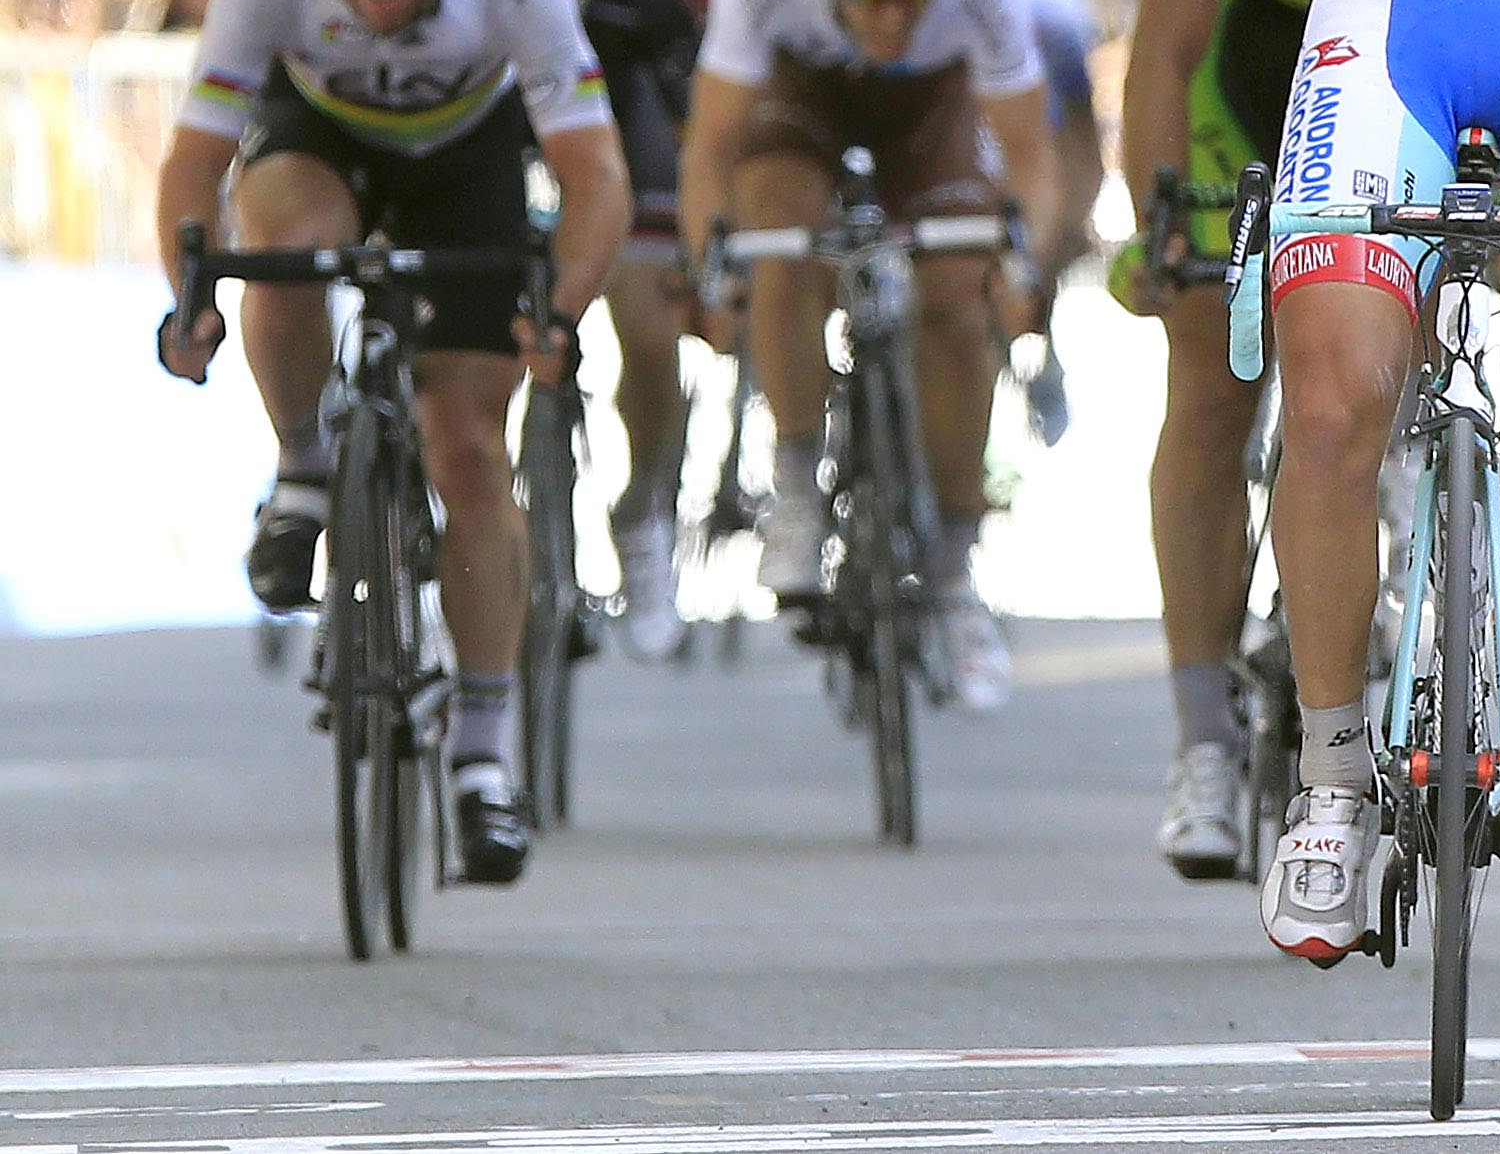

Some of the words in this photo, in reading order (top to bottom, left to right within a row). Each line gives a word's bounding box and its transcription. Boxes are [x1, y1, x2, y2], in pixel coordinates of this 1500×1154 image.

[1299, 85, 1342, 204] ANDRON
[1231, 198, 1258, 265] SRAM
[1303, 837, 1346, 854] LAKE
